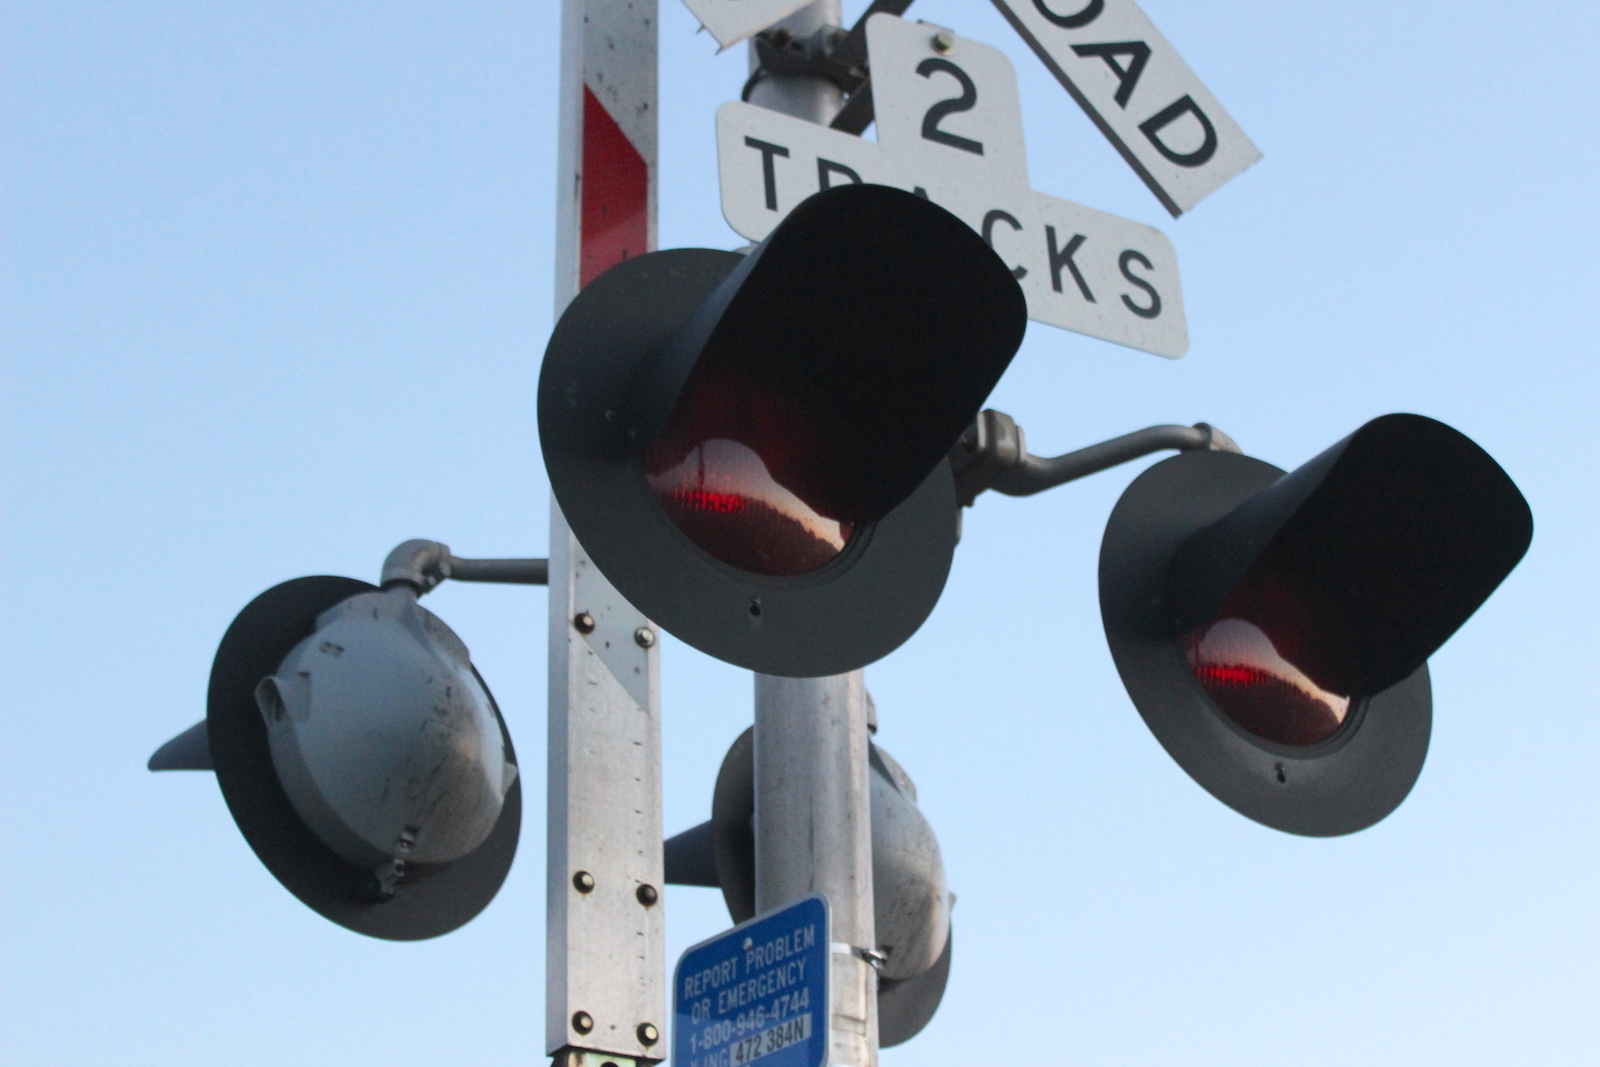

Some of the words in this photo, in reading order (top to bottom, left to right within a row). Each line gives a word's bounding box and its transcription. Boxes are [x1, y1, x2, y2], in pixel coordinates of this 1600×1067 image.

[915, 58, 984, 156] 2
[744, 135, 1162, 320] TCKS
[684, 957, 738, 1000] REPORT
[745, 924, 815, 974] PROBLEM
[691, 998, 711, 1024] OR
[718, 957, 806, 1014] EMERGENCY
[690, 987, 809, 1054] 1-800-946-4744
[735, 1035, 762, 1063] 472
[766, 1017, 804, 1052] 384N
